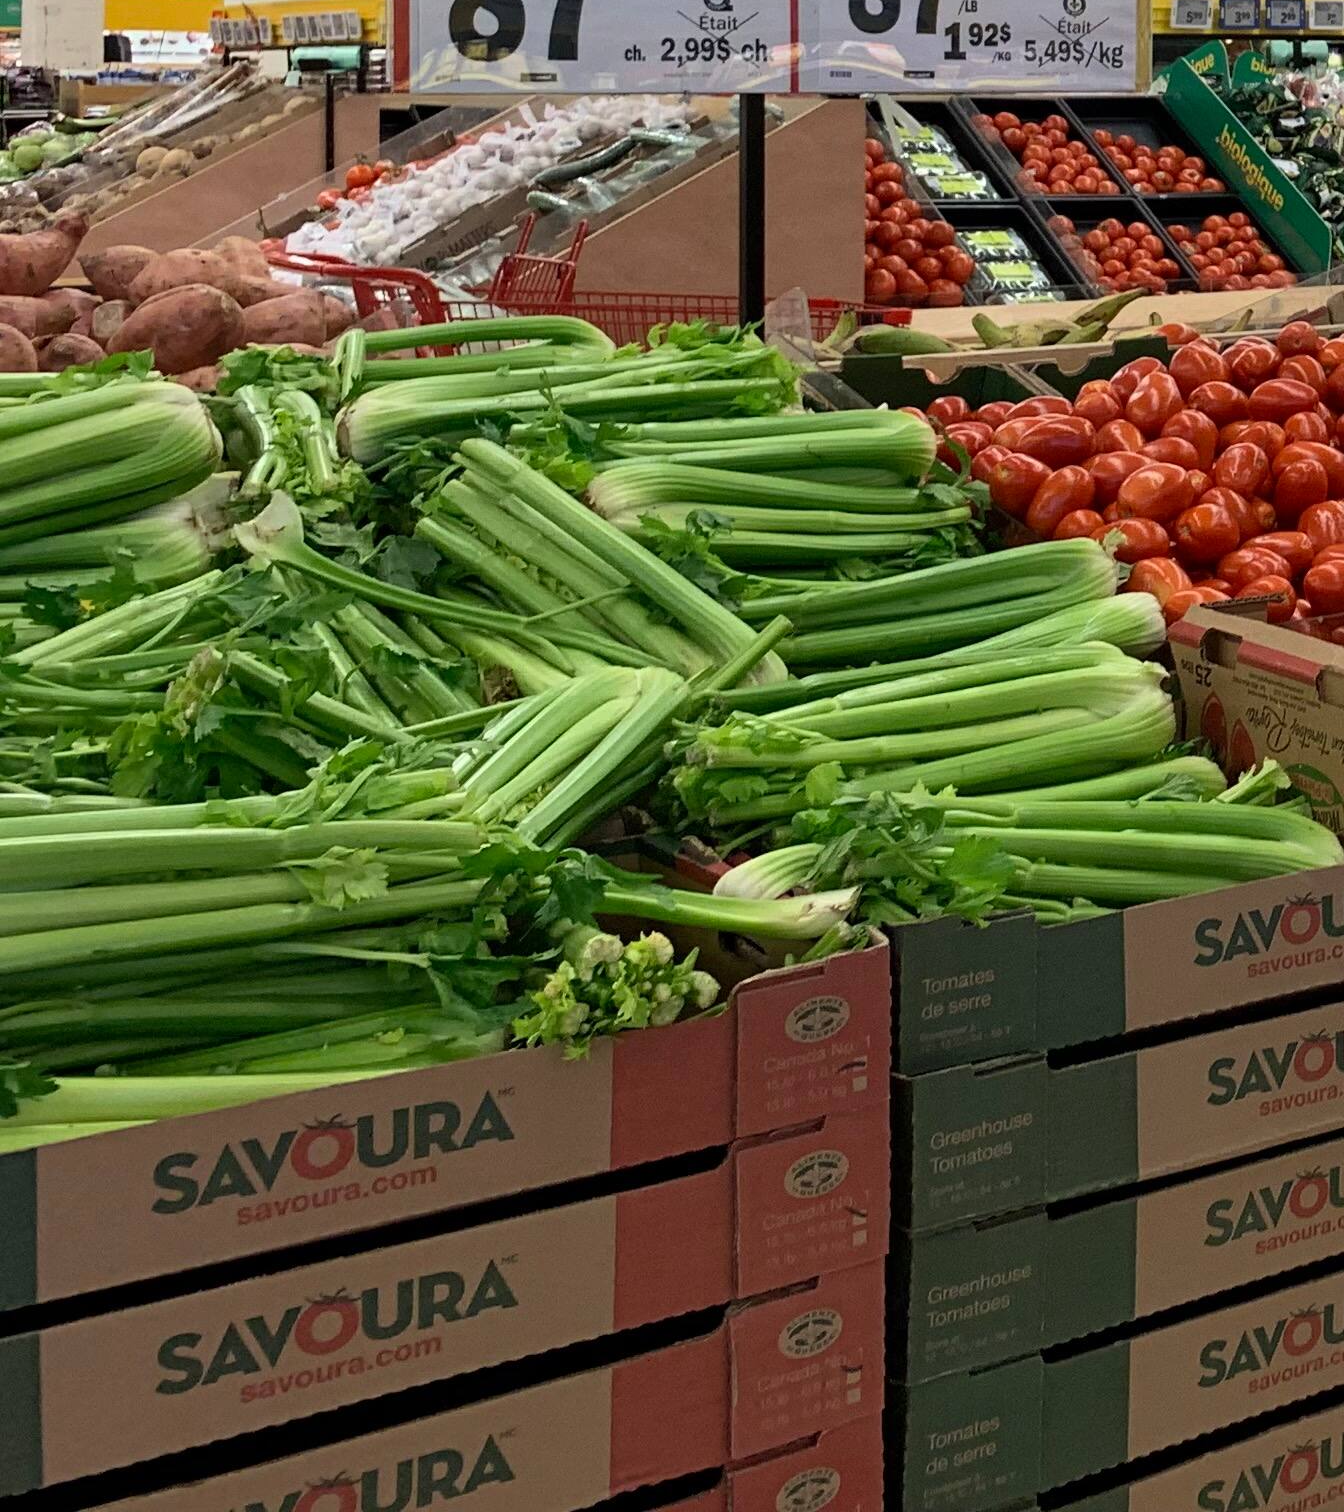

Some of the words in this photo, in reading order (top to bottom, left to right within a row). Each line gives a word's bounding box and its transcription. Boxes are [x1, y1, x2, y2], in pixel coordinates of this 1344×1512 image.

[699, 12, 739, 32] Était
[1057, 16, 1092, 35] Était
[624, 44, 647, 63] ch.
[1216, 123, 1285, 213] biologique
[921, 969, 995, 996] Tomates
[921, 1001, 944, 1021] de
[949, 992, 992, 1016] serre
[930, 1111, 1034, 1151] Greenhouse
[152, 1090, 515, 1215] SAVOURA
[929, 1139, 1013, 1175] Tomatoes
[236, 1163, 438, 1227] savoura.com
[927, 1264, 1033, 1306] Greenhouse
[155, 1258, 519, 1395] SAVOURA
[240, 1336, 443, 1405] savoura.com
